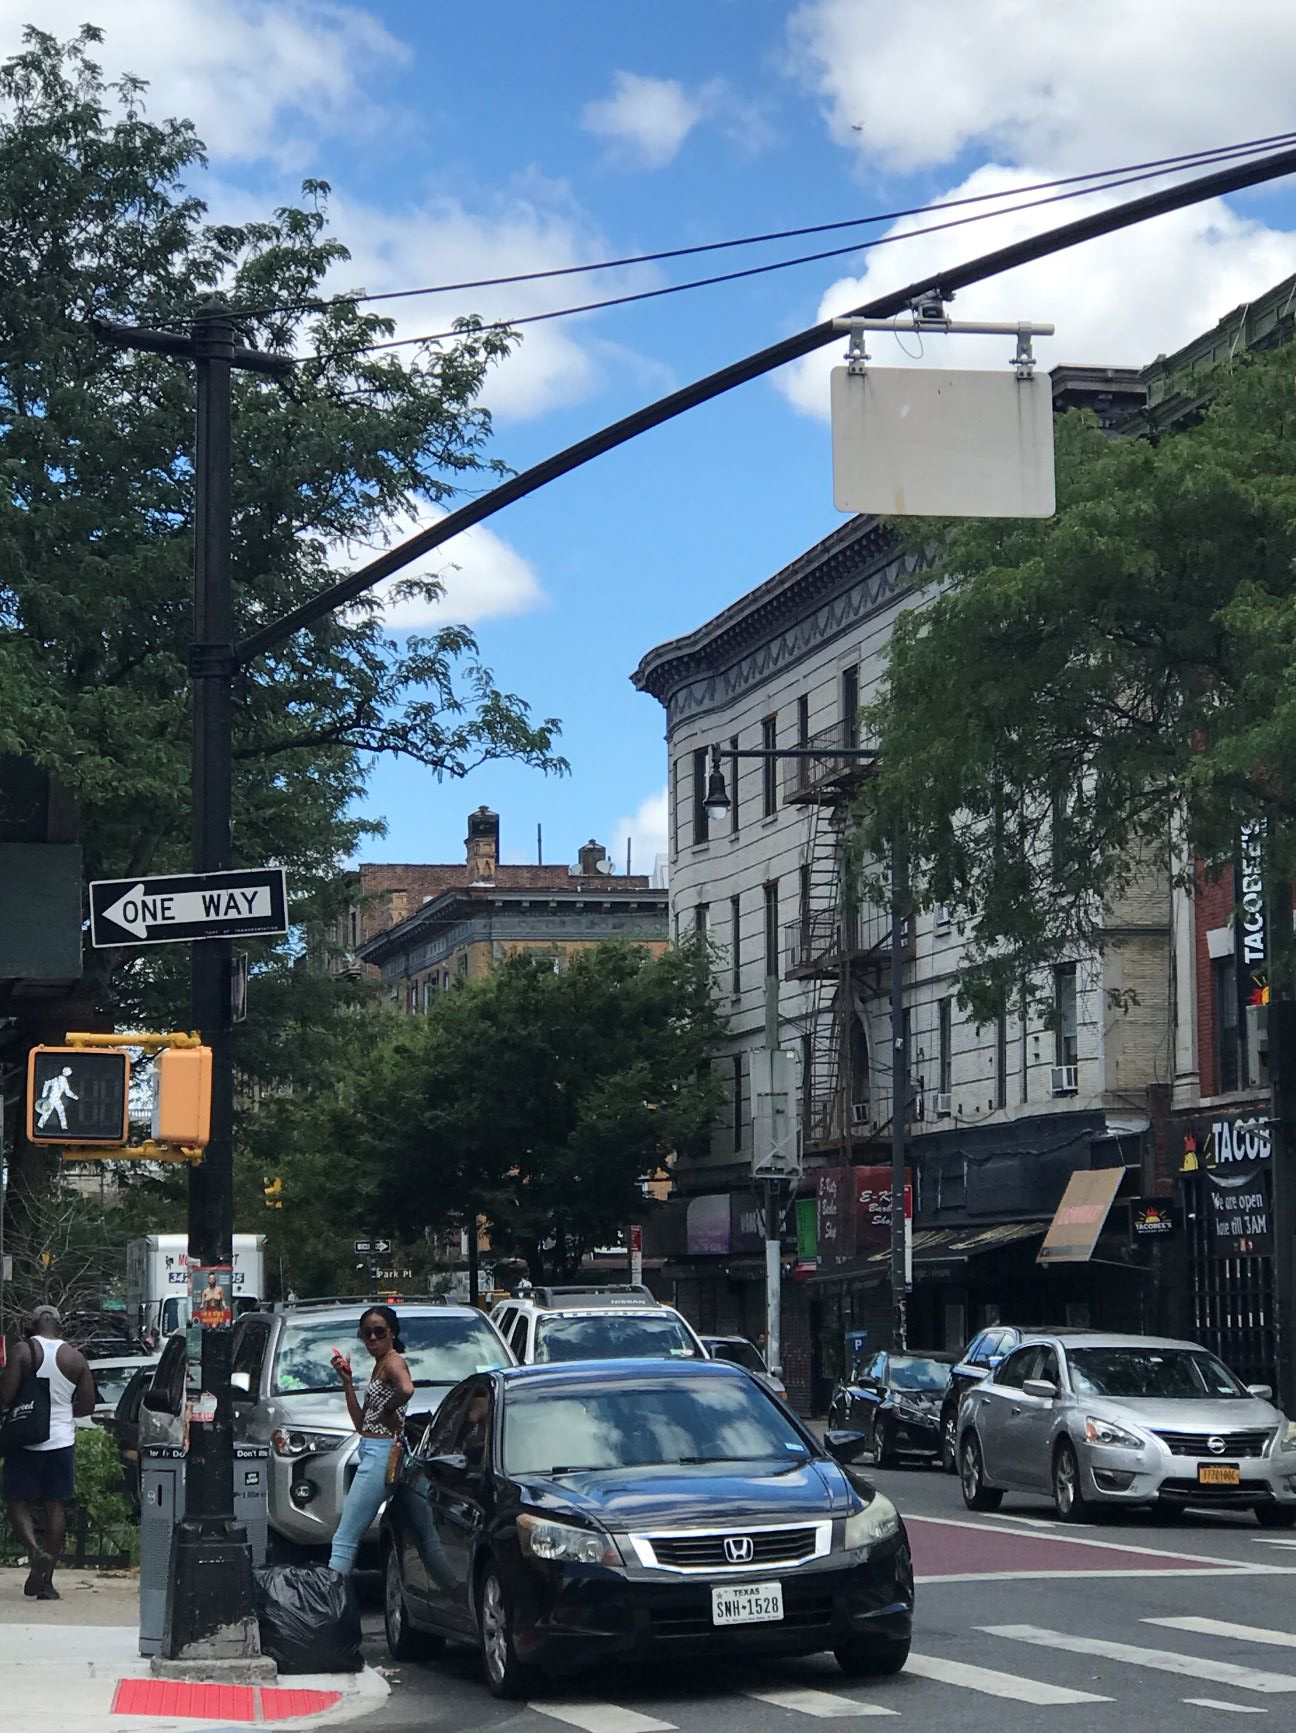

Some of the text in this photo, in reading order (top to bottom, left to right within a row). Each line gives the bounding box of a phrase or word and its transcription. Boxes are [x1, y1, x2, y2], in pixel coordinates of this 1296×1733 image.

[123, 890, 258, 924] ONE WAY
[1211, 1192, 1224, 1211] We
[1239, 1193, 1264, 1213] open
[1231, 1215, 1244, 1235] till
[1245, 1214, 1268, 1235] 3AM
[377, 1269, 413, 1279] Park Pl
[855, 1339, 862, 1351] P
[733, 1588, 760, 1597] TEXAS
